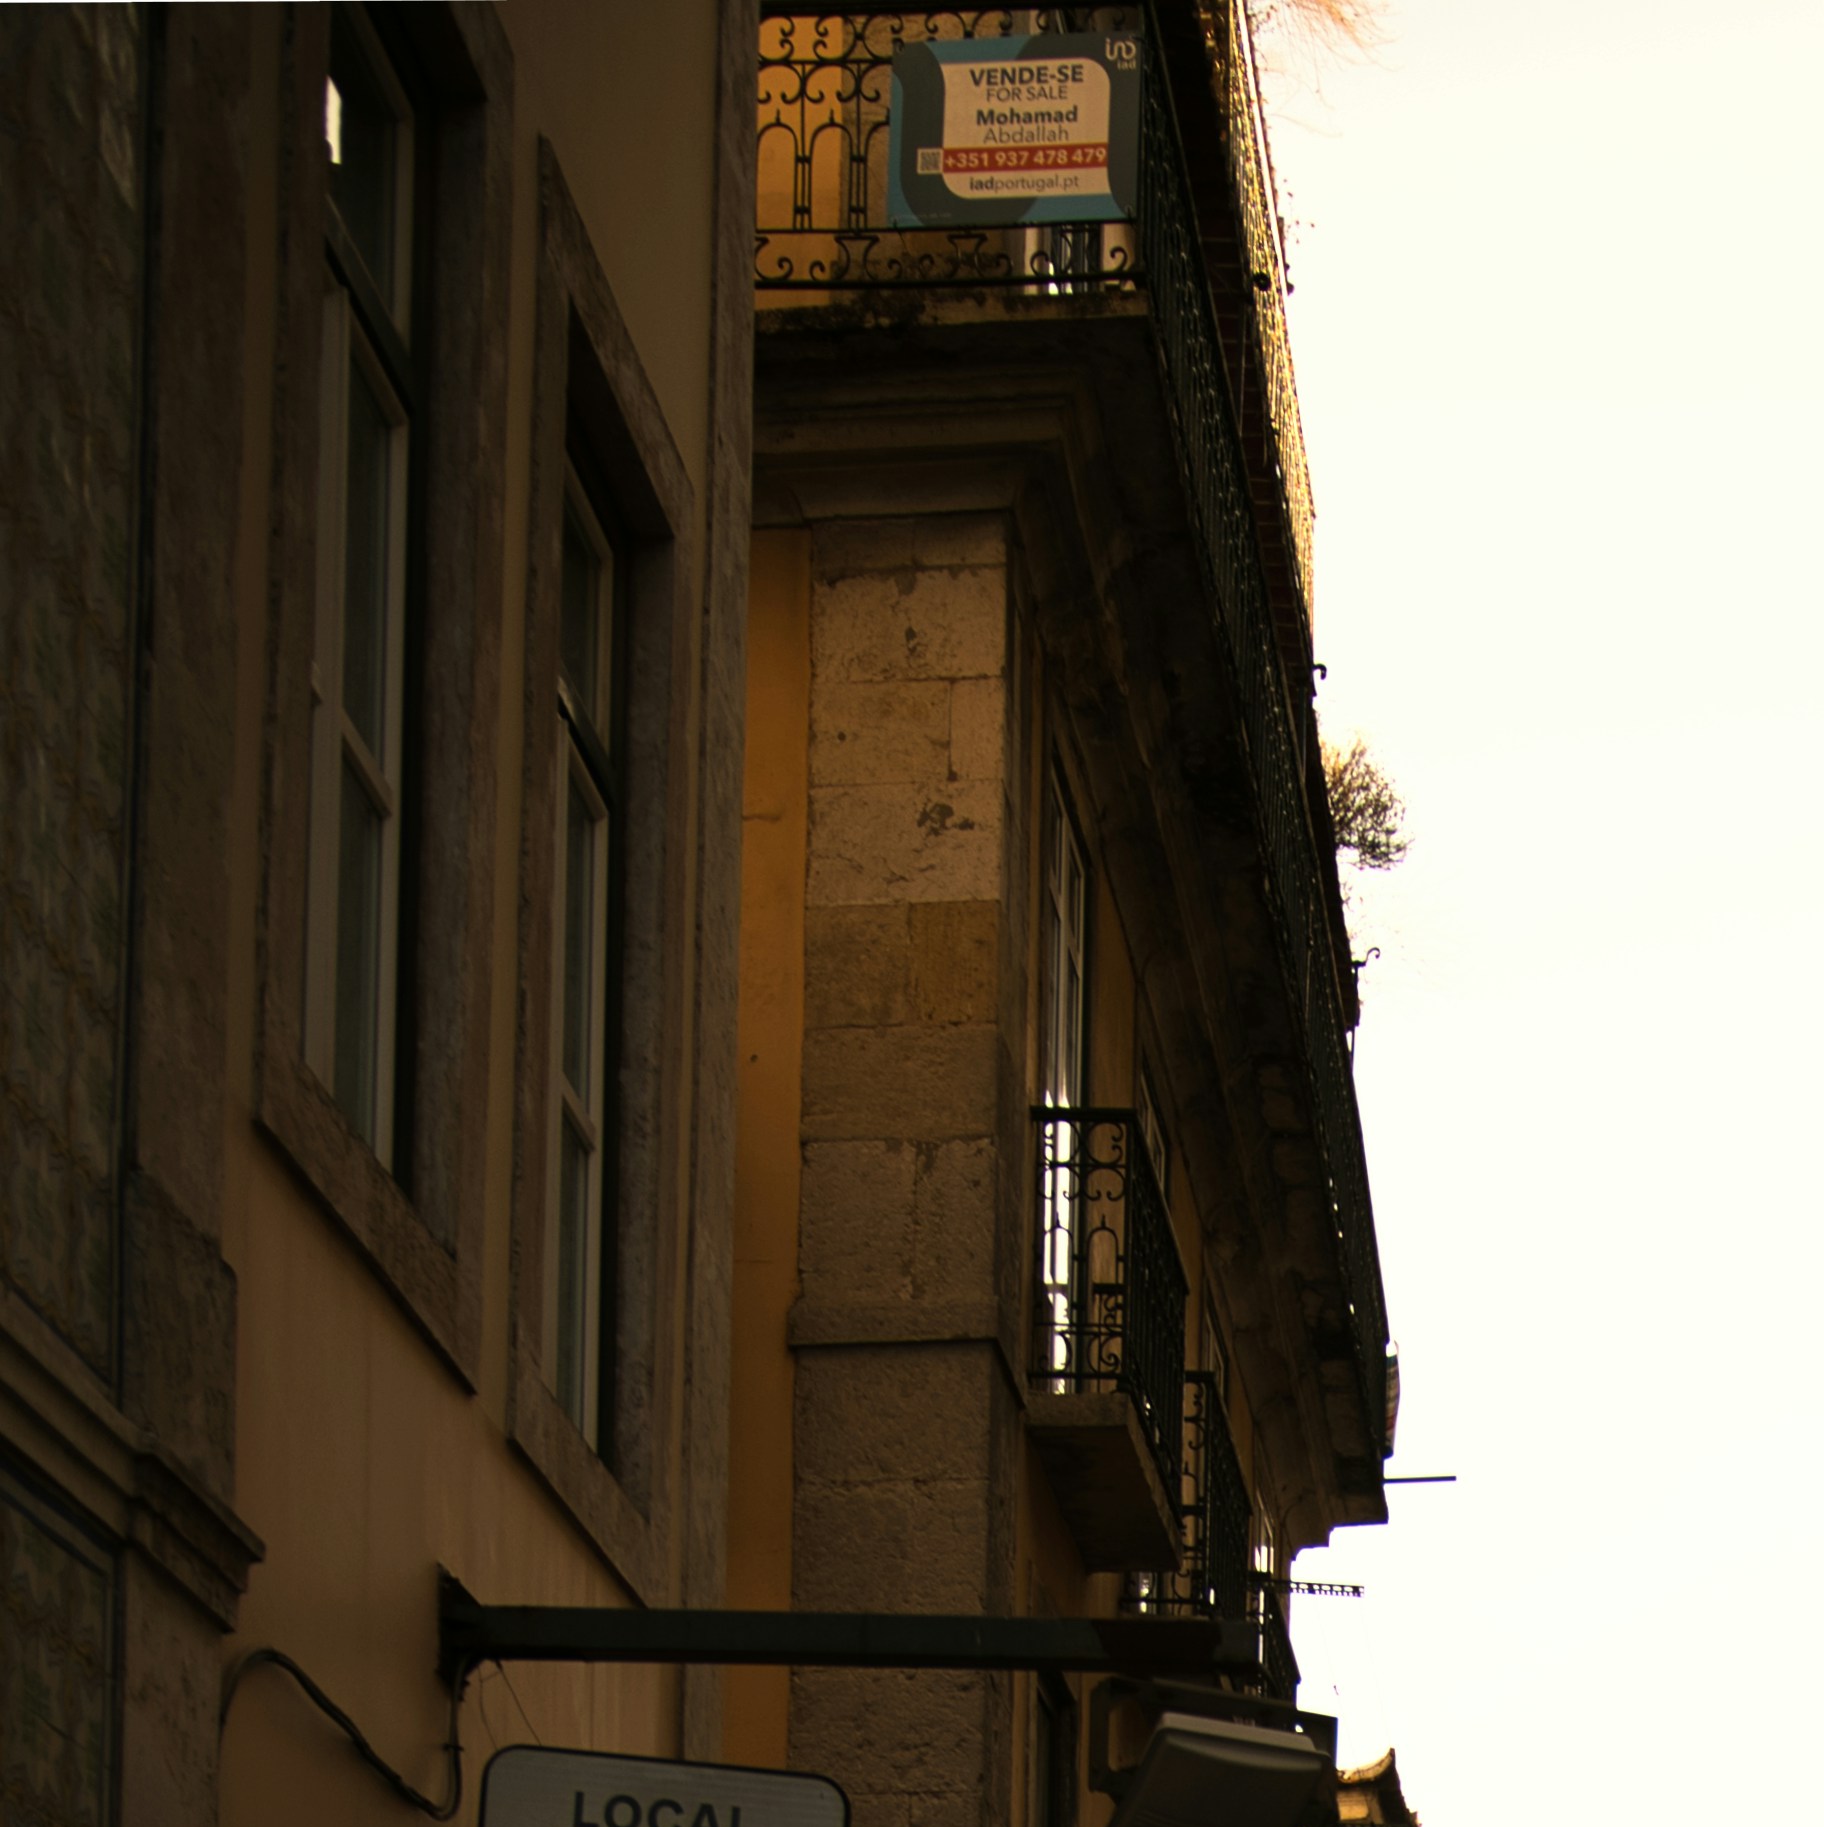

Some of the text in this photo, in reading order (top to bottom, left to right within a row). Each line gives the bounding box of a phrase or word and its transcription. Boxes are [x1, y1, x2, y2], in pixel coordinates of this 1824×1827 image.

[970, 65, 1083, 87] VENDE-SE
[986, 85, 1068, 102] FOR SALE
[977, 106, 1078, 125] Mohamad
[983, 126, 1069, 144] Abdallah
[944, 148, 1107, 168] +351 937 478 479
[970, 175, 1079, 194] iadportugal.pt
